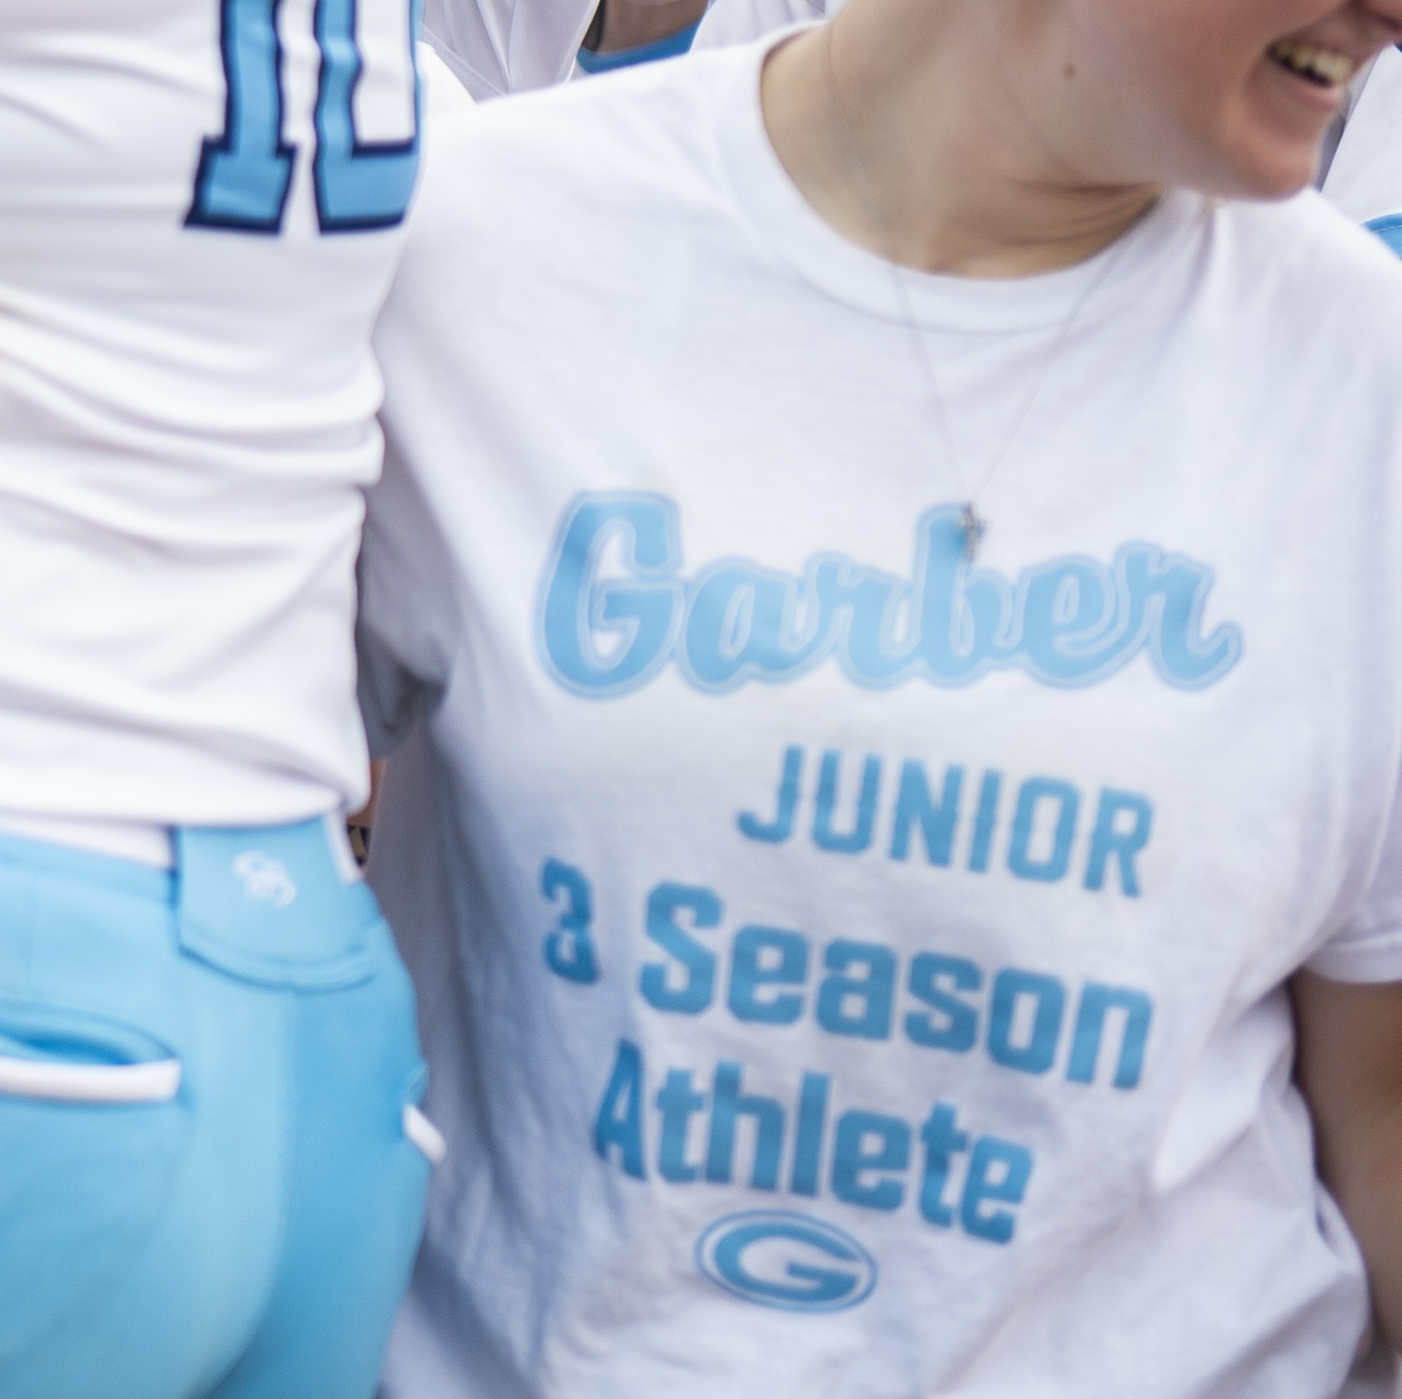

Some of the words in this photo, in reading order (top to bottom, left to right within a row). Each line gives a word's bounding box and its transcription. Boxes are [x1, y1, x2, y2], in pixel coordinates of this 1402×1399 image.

[534, 488, 1243, 699] Garber
[735, 742, 1153, 898] JUNIOR
[540, 856, 601, 986] 3
[637, 879, 1154, 1091] Season
[591, 1037, 1035, 1246] Athlete
